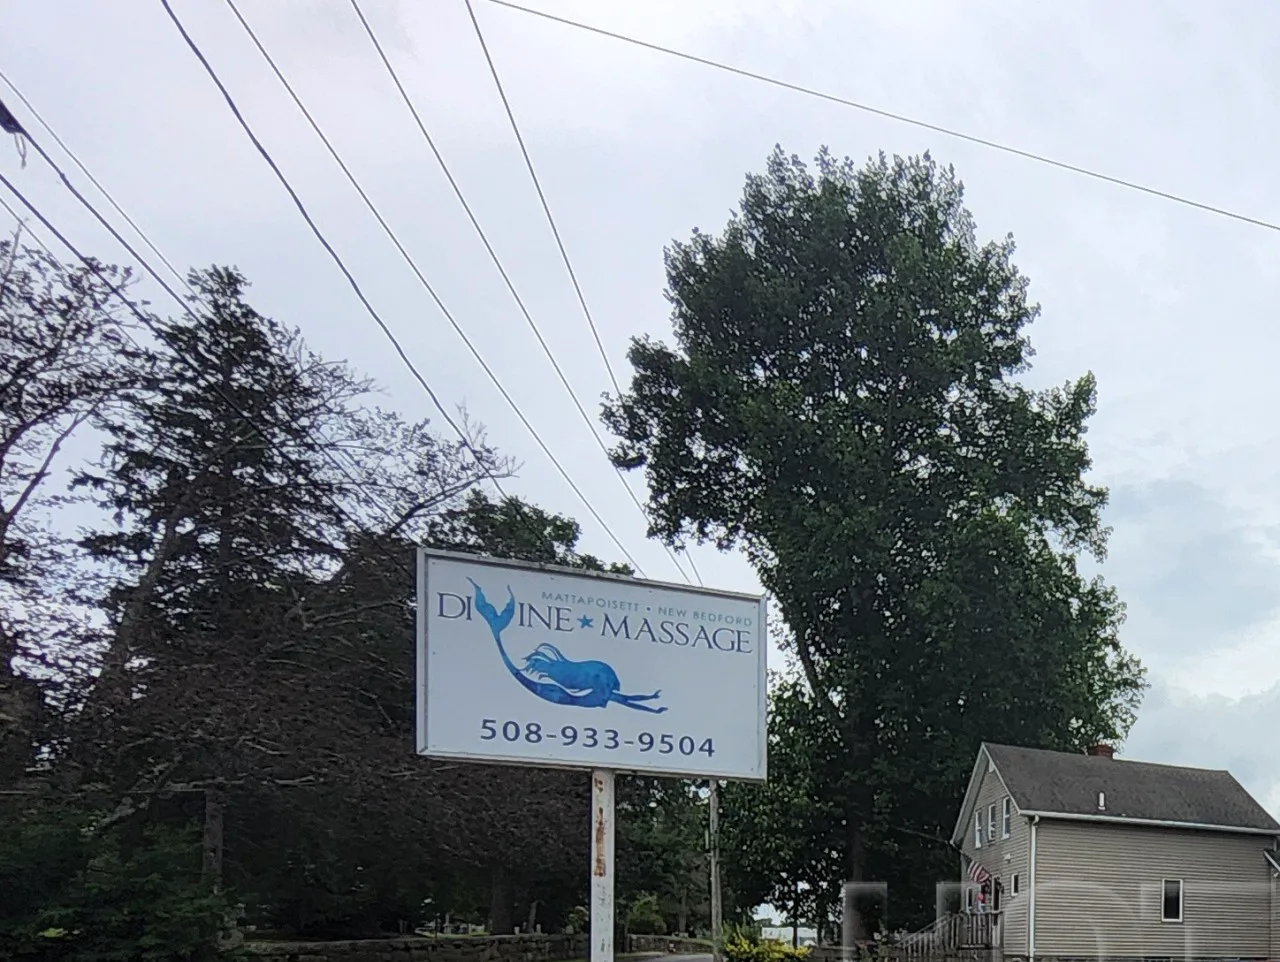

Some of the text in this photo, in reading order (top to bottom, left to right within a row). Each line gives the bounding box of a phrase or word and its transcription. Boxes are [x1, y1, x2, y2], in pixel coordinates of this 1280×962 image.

[436, 579, 754, 654] DIVINE MASSAGE
[541, 591, 753, 627] MATTAPOISETT NEW BEDFORD
[479, 719, 716, 758] 508-933-9504
